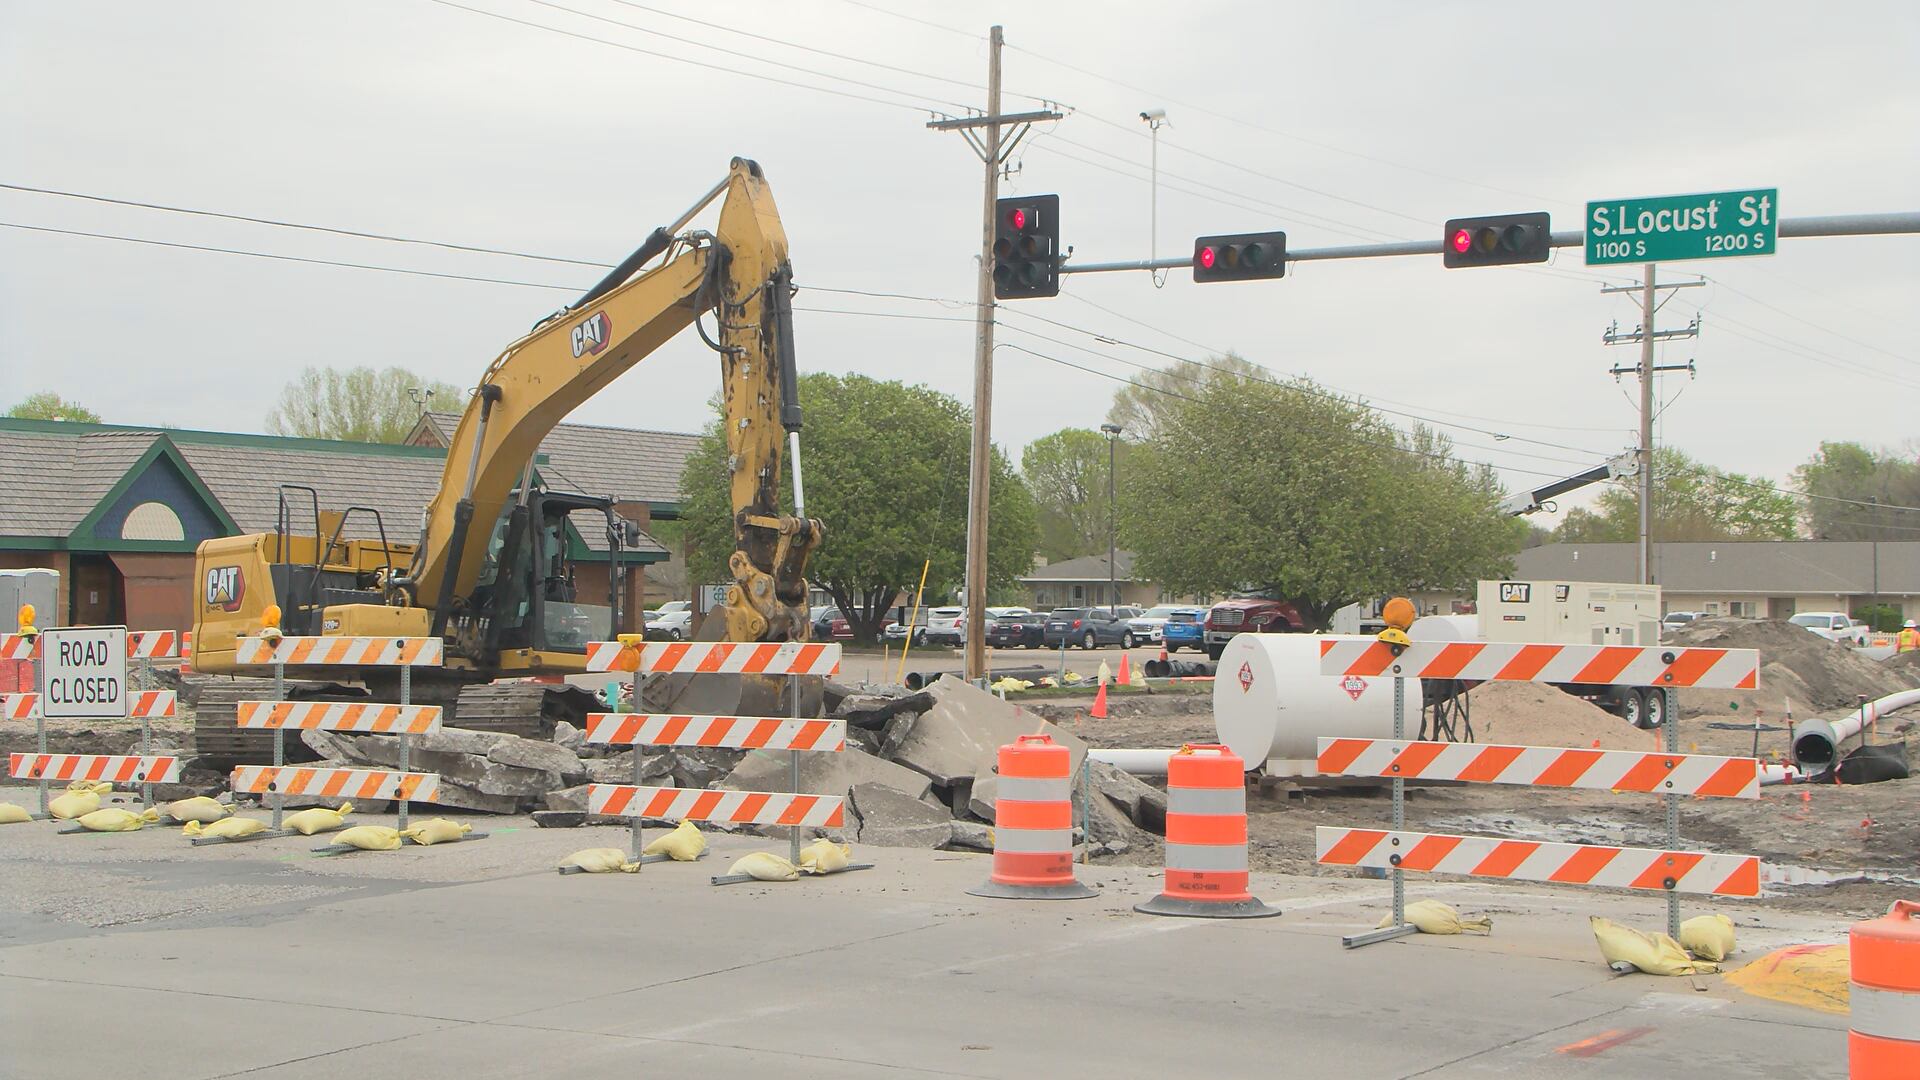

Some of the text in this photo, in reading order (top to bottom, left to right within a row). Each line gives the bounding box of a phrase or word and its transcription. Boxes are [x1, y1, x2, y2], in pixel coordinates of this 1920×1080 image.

[1738, 195, 1771, 227] St
[1595, 240, 1646, 258] 1100 S
[1705, 232, 1765, 252] 1200 S
[571, 312, 601, 358] CAT
[207, 567, 238, 603] CAT
[1502, 584, 1528, 601] CAT
[60, 640, 108, 666] ROAD
[50, 677, 118, 703] CLOSED
